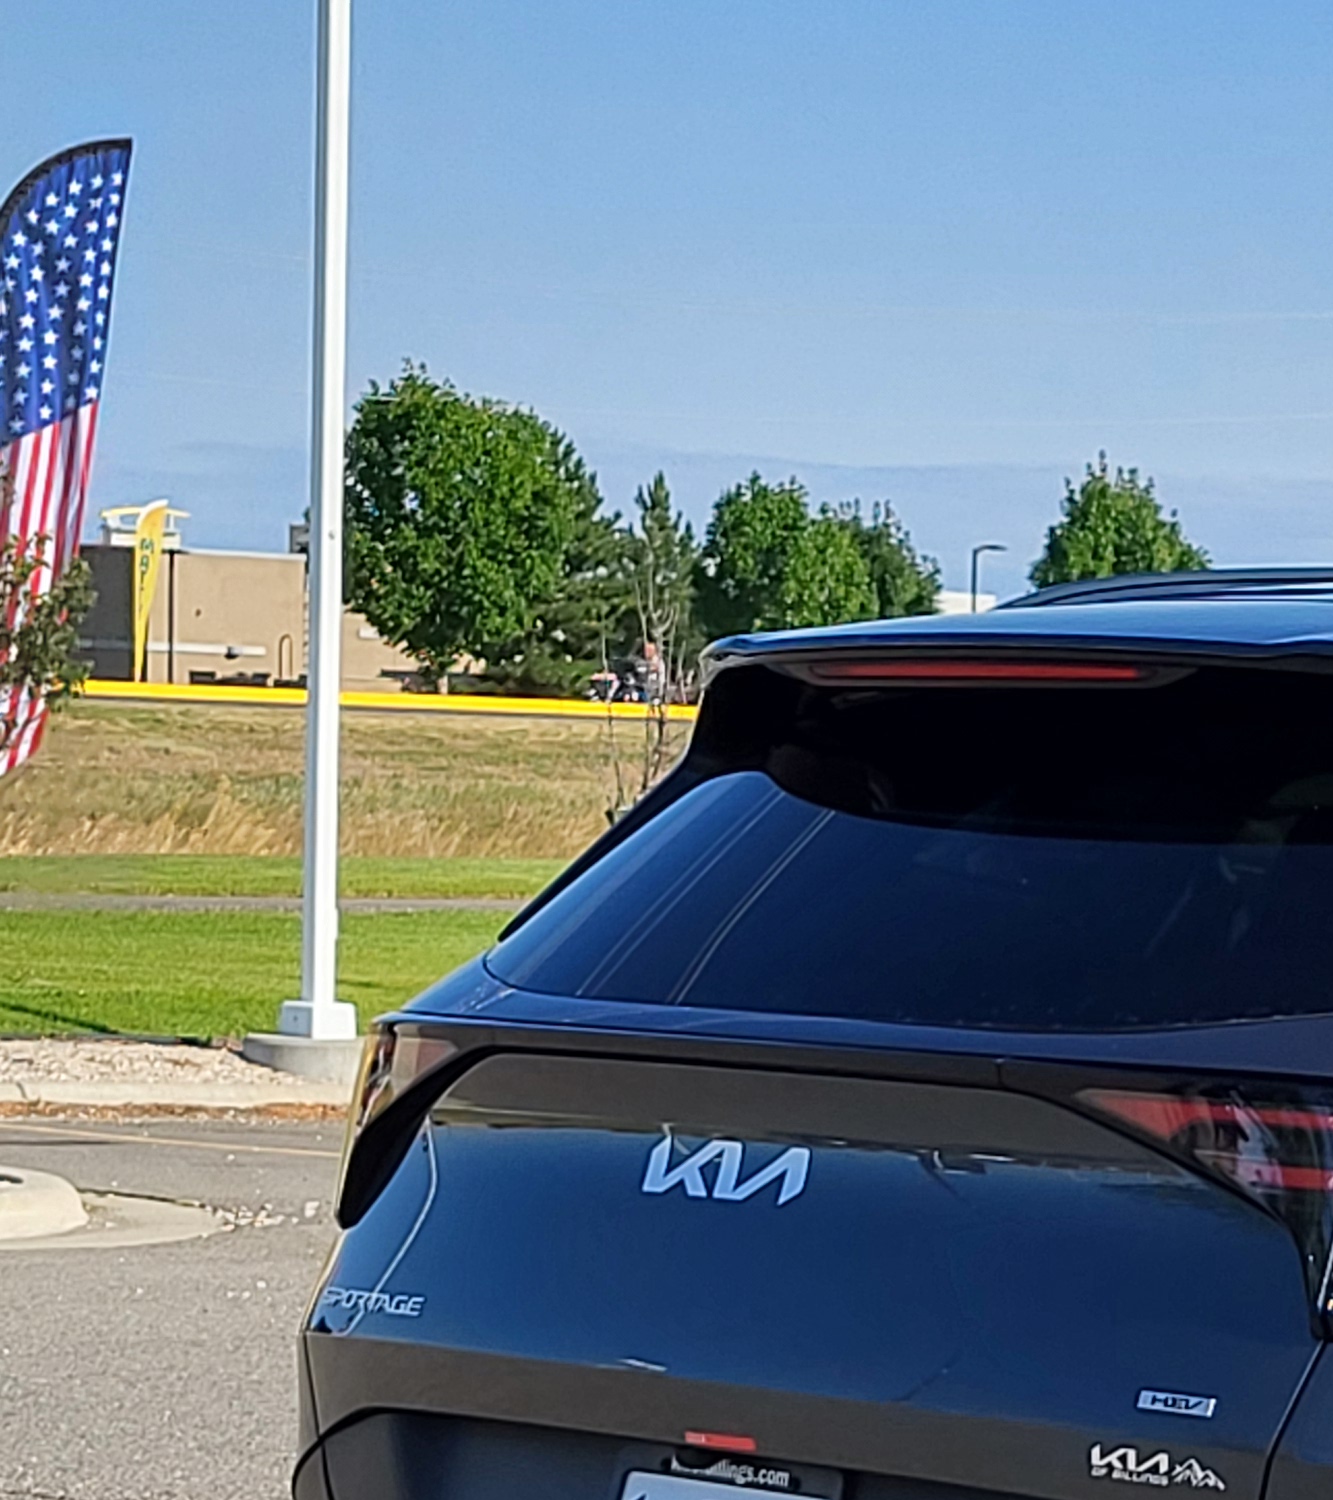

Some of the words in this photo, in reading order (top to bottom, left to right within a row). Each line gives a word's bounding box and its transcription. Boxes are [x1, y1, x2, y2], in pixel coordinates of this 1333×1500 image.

[642, 1135, 811, 1206] KIA
[323, 1287, 425, 1316] SPORTAGE
[1090, 1444, 1170, 1475] KIA
